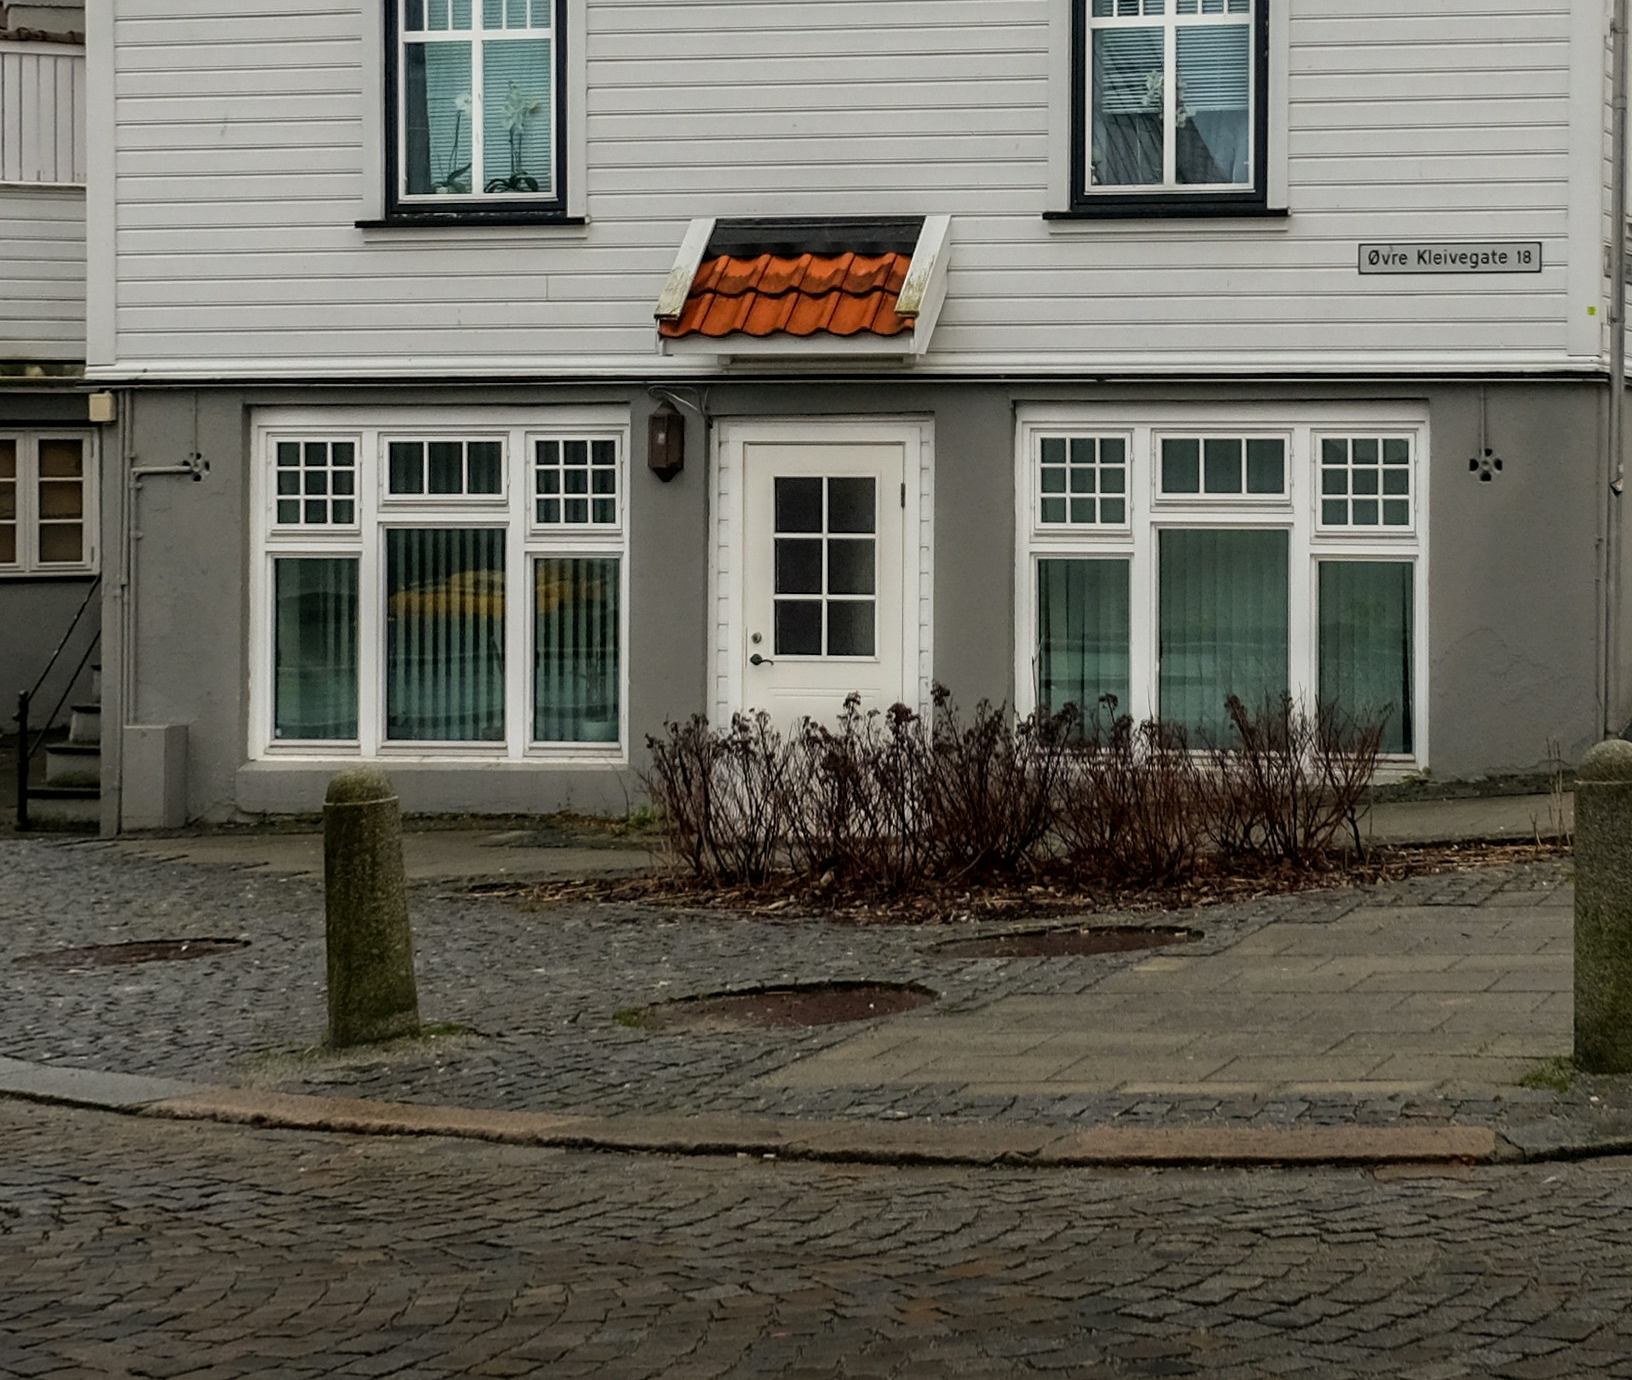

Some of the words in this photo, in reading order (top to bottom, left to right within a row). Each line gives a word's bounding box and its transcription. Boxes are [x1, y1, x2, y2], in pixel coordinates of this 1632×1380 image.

[1368, 249, 1408, 265] Øvre
[1417, 249, 1508, 269] Kleivegate
[1516, 250, 1532, 264] 18
